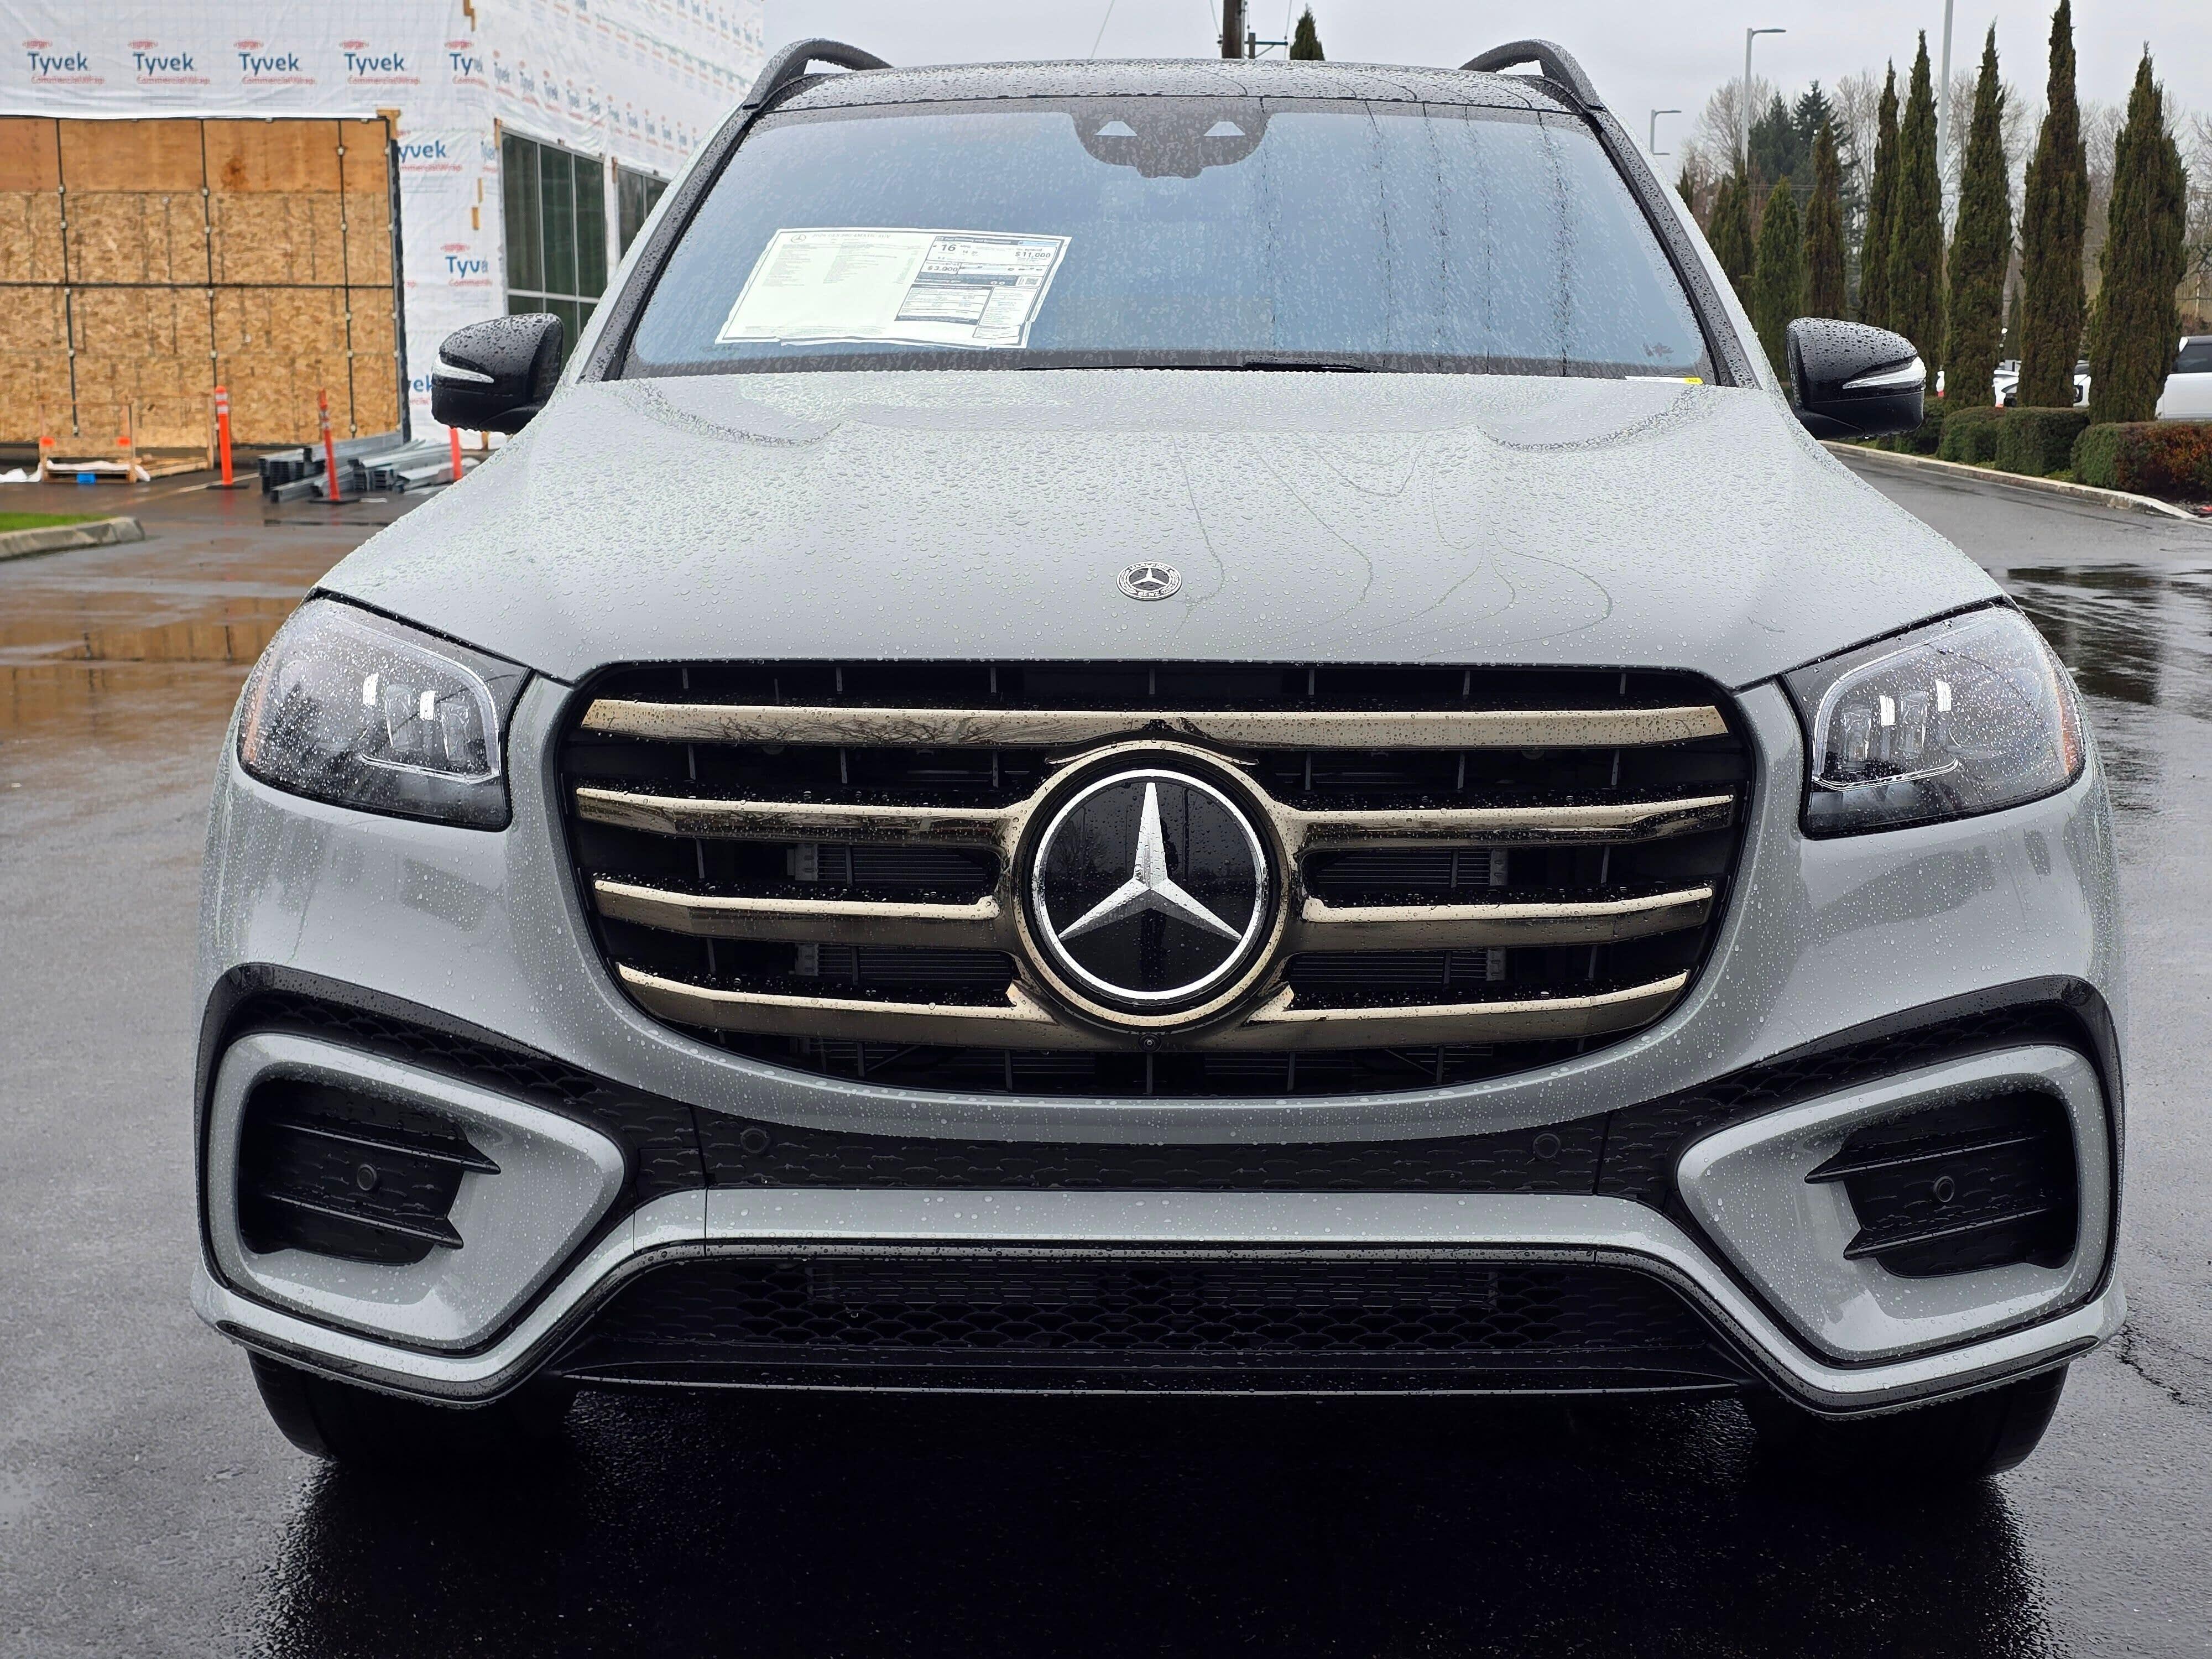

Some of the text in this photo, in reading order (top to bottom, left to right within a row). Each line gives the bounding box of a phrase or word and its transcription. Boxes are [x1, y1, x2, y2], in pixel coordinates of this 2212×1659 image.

[27, 51, 88, 76] Tyvek
[133, 51, 194, 76] Tyvek
[238, 52, 299, 76] Tyvek
[344, 52, 404, 76] Tyvek
[398, 140, 447, 163] yvek
